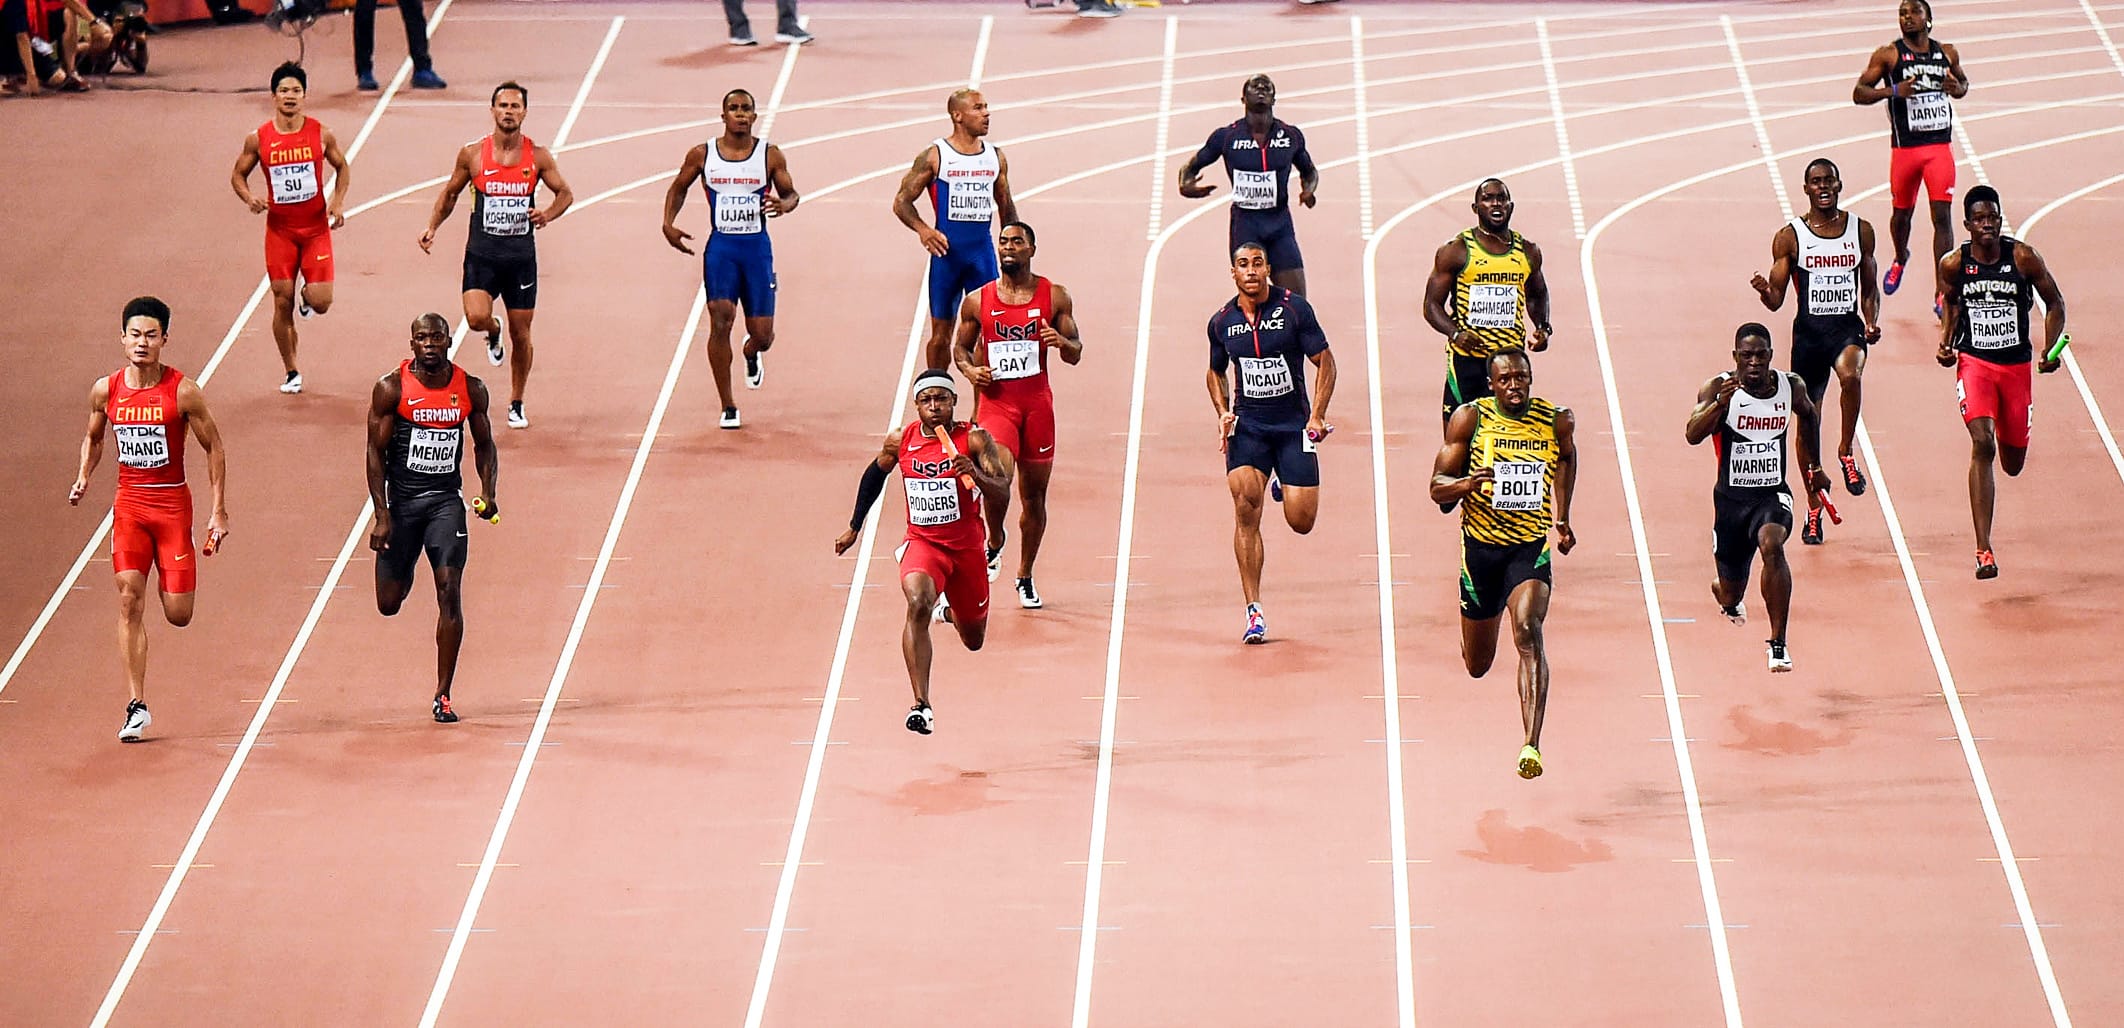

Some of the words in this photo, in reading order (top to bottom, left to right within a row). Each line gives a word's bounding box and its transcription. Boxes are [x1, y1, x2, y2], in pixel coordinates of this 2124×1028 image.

[1902, 64, 1948, 80] ANTIGU
[1920, 93, 1944, 103] TDK
[1910, 105, 1947, 121] JARVIS
[270, 146, 313, 165] CHINA
[281, 164, 311, 175] TDK
[946, 169, 970, 177] GREAT
[710, 177, 732, 185] GREAT
[1246, 173, 1271, 182] TDK
[285, 178, 302, 192] SU
[485, 181, 530, 195] GERMANY
[964, 182, 989, 191] TDK
[1235, 185, 1274, 199] ANOUMAN
[499, 199, 526, 208] TDK
[730, 195, 756, 205] TDK
[950, 195, 992, 209] ELLINGTON
[720, 209, 755, 222] UJAH
[1806, 254, 1856, 269] CANADA
[1474, 272, 1525, 283] JAMAICA
[1825, 275, 1852, 285] TDK
[1485, 287, 1514, 296] TDK
[1962, 280, 2018, 296] ANTIGUA
[1811, 289, 1854, 303] RODNEY
[1471, 301, 1515, 316] ASHMEADE
[1811, 306, 1839, 314] BEIJING
[1983, 308, 2013, 319] TDK
[1471, 318, 1499, 327] BEIJING
[995, 320, 1037, 341] USA
[1973, 321, 2016, 338] FRANCIS
[1004, 342, 1033, 352] TDK
[1974, 340, 2000, 348] BEIJING
[2001, 337, 2017, 346] 2015
[999, 357, 1028, 373] GAY
[1253, 359, 1285, 370] TDK
[1245, 371, 1287, 388] VICAUT
[1246, 388, 1274, 397] BEIJING
[1275, 386, 1292, 395] 2015
[115, 406, 164, 422] CHINA
[413, 409, 461, 422] GERMANY
[1737, 415, 1787, 431] CANADA
[127, 426, 161, 437] TDK
[427, 430, 458, 441] TDK
[120, 440, 164, 456] ZHANG
[1493, 438, 1549, 451] JAMAICA
[1747, 442, 1777, 454] TDK
[411, 444, 454, 461] MENGA
[409, 462, 438, 472] BEIJING
[912, 458, 951, 479] USA
[1513, 463, 1543, 475] TDK
[1731, 457, 1778, 475] WARNER
[920, 480, 952, 492] TDK
[1732, 477, 1762, 486] BEIJING
[1501, 480, 1539, 496] BOLT
[909, 495, 956, 512] RODGERS
[1495, 501, 1526, 509] BEIJING
[912, 515, 938, 524] BEIJING
[939, 512, 958, 522] 2015
